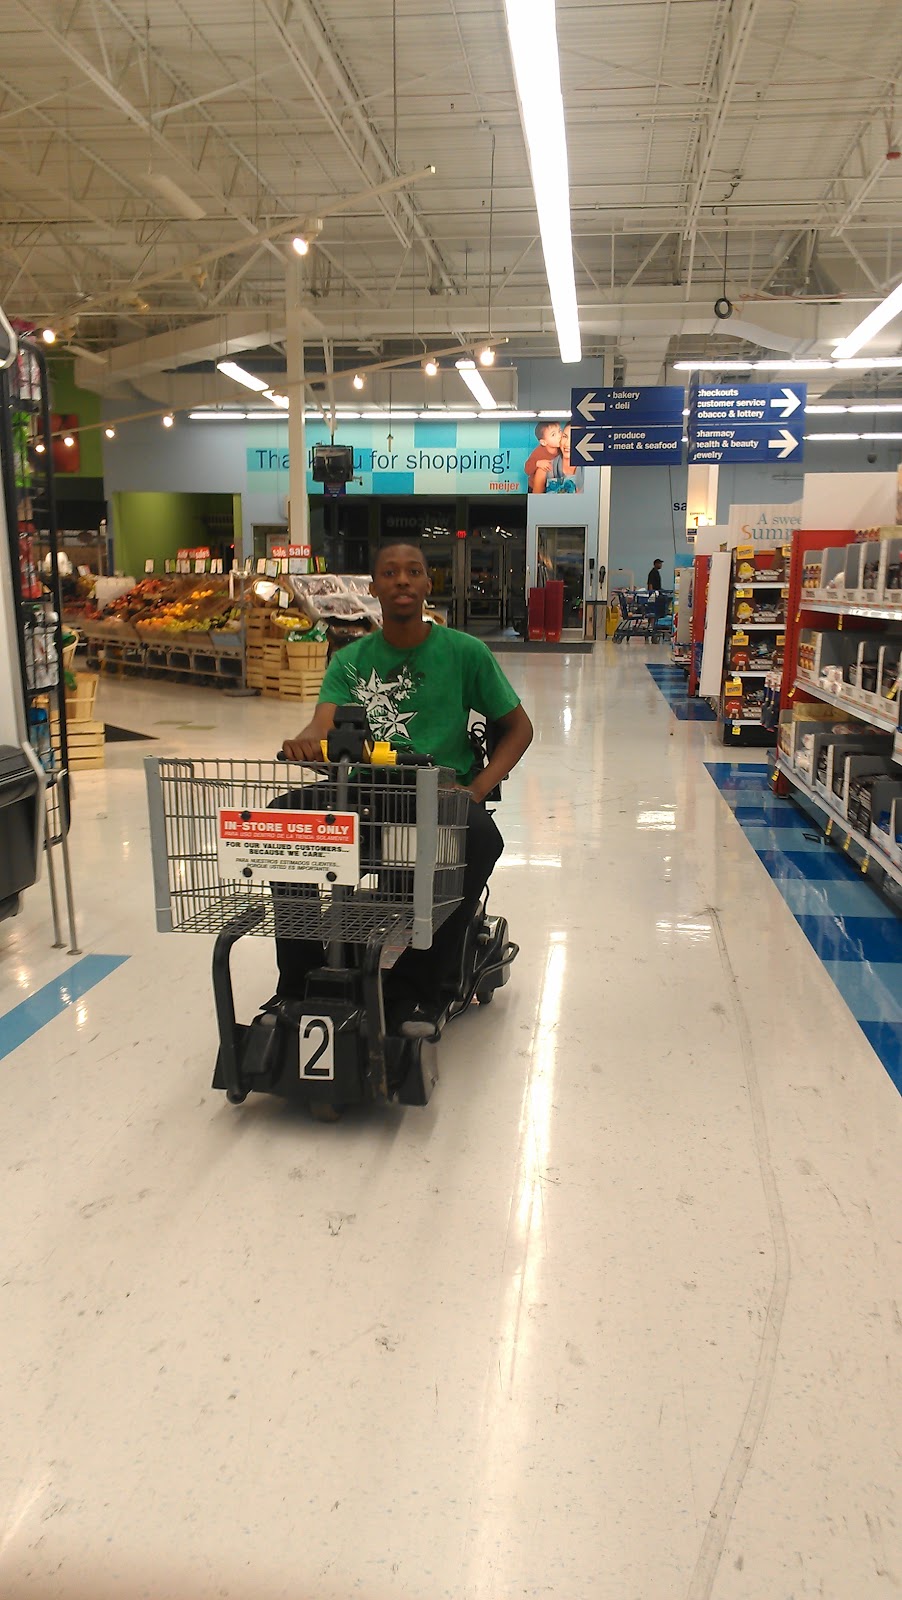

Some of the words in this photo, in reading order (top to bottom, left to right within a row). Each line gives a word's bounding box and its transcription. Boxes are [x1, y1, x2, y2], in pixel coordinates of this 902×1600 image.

[612, 391, 640, 400] bakery
[615, 401, 630, 410] deli
[697, 399, 734, 408] customer
[736, 399, 766, 407] service
[697, 409, 727, 419] obacco
[729, 410, 736, 418] &
[737, 409, 764, 420] lottery
[613, 431, 646, 441] produce
[613, 441, 634, 450] meat
[635, 441, 643, 450] &
[644, 440, 677, 450] seafood
[722, 440, 729, 448] &
[730, 439, 758, 450] beauty
[693, 451, 723, 461] jewelry
[255, 450, 316, 469] Thak
[370, 450, 398, 469] for
[405, 450, 511, 475] shopping!
[488, 480, 520, 492] meijer
[757, 513, 768, 525] A
[289, 545, 310, 557] sale
[224, 820, 283, 832] IN-STORE
[287, 823, 313, 834] USE
[317, 824, 350, 835] ONLY
[249, 848, 284, 856] BECAUSE
[303, 1019, 330, 1077] 2
